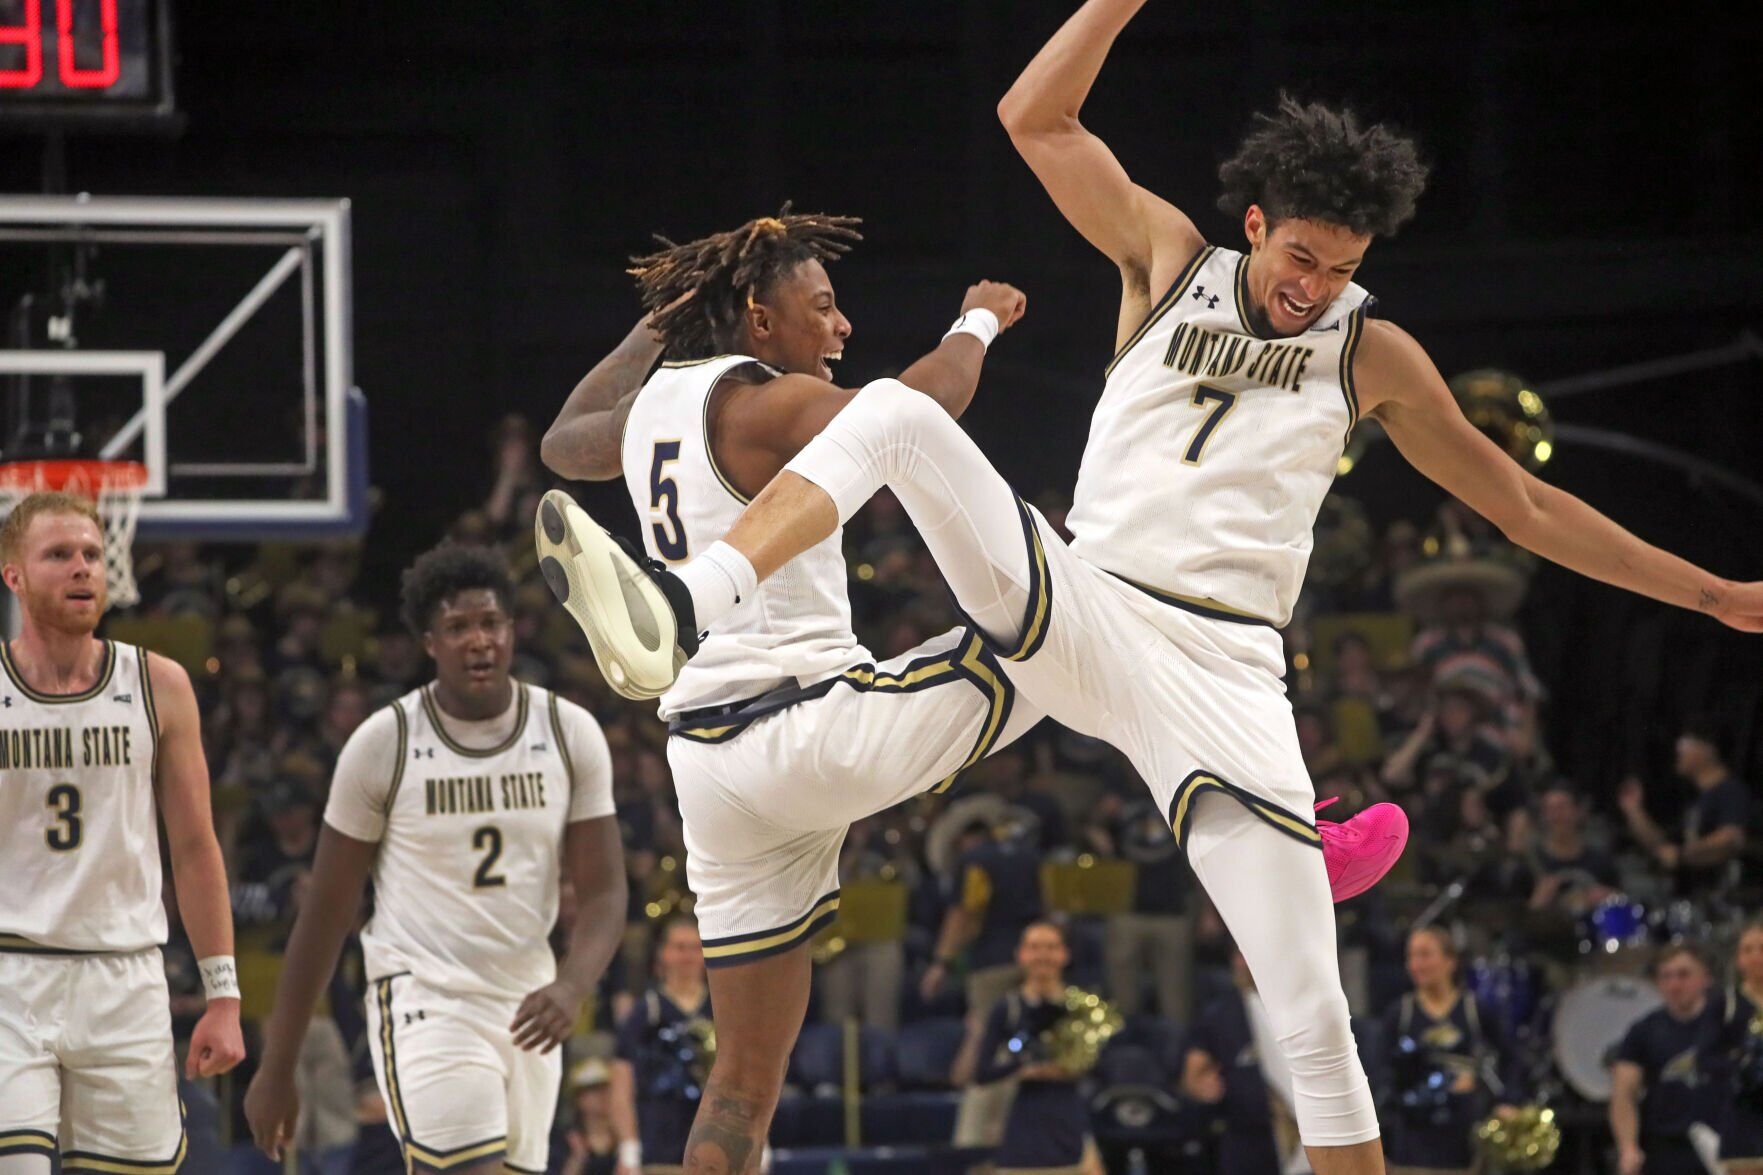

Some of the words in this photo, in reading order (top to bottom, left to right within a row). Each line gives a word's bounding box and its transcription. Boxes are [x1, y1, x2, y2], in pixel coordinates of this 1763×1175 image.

[1163, 321, 1251, 378] MONTANA
[1247, 341, 1315, 393] STATE
[1180, 381, 1240, 467] 7
[649, 437, 692, 565] 5
[0, 727, 73, 769] MONTANA
[82, 726, 131, 767] STATE
[44, 781, 84, 854] 3
[425, 775, 495, 816] MONTANA
[500, 772, 546, 810] STATE
[472, 825, 507, 889] 2
